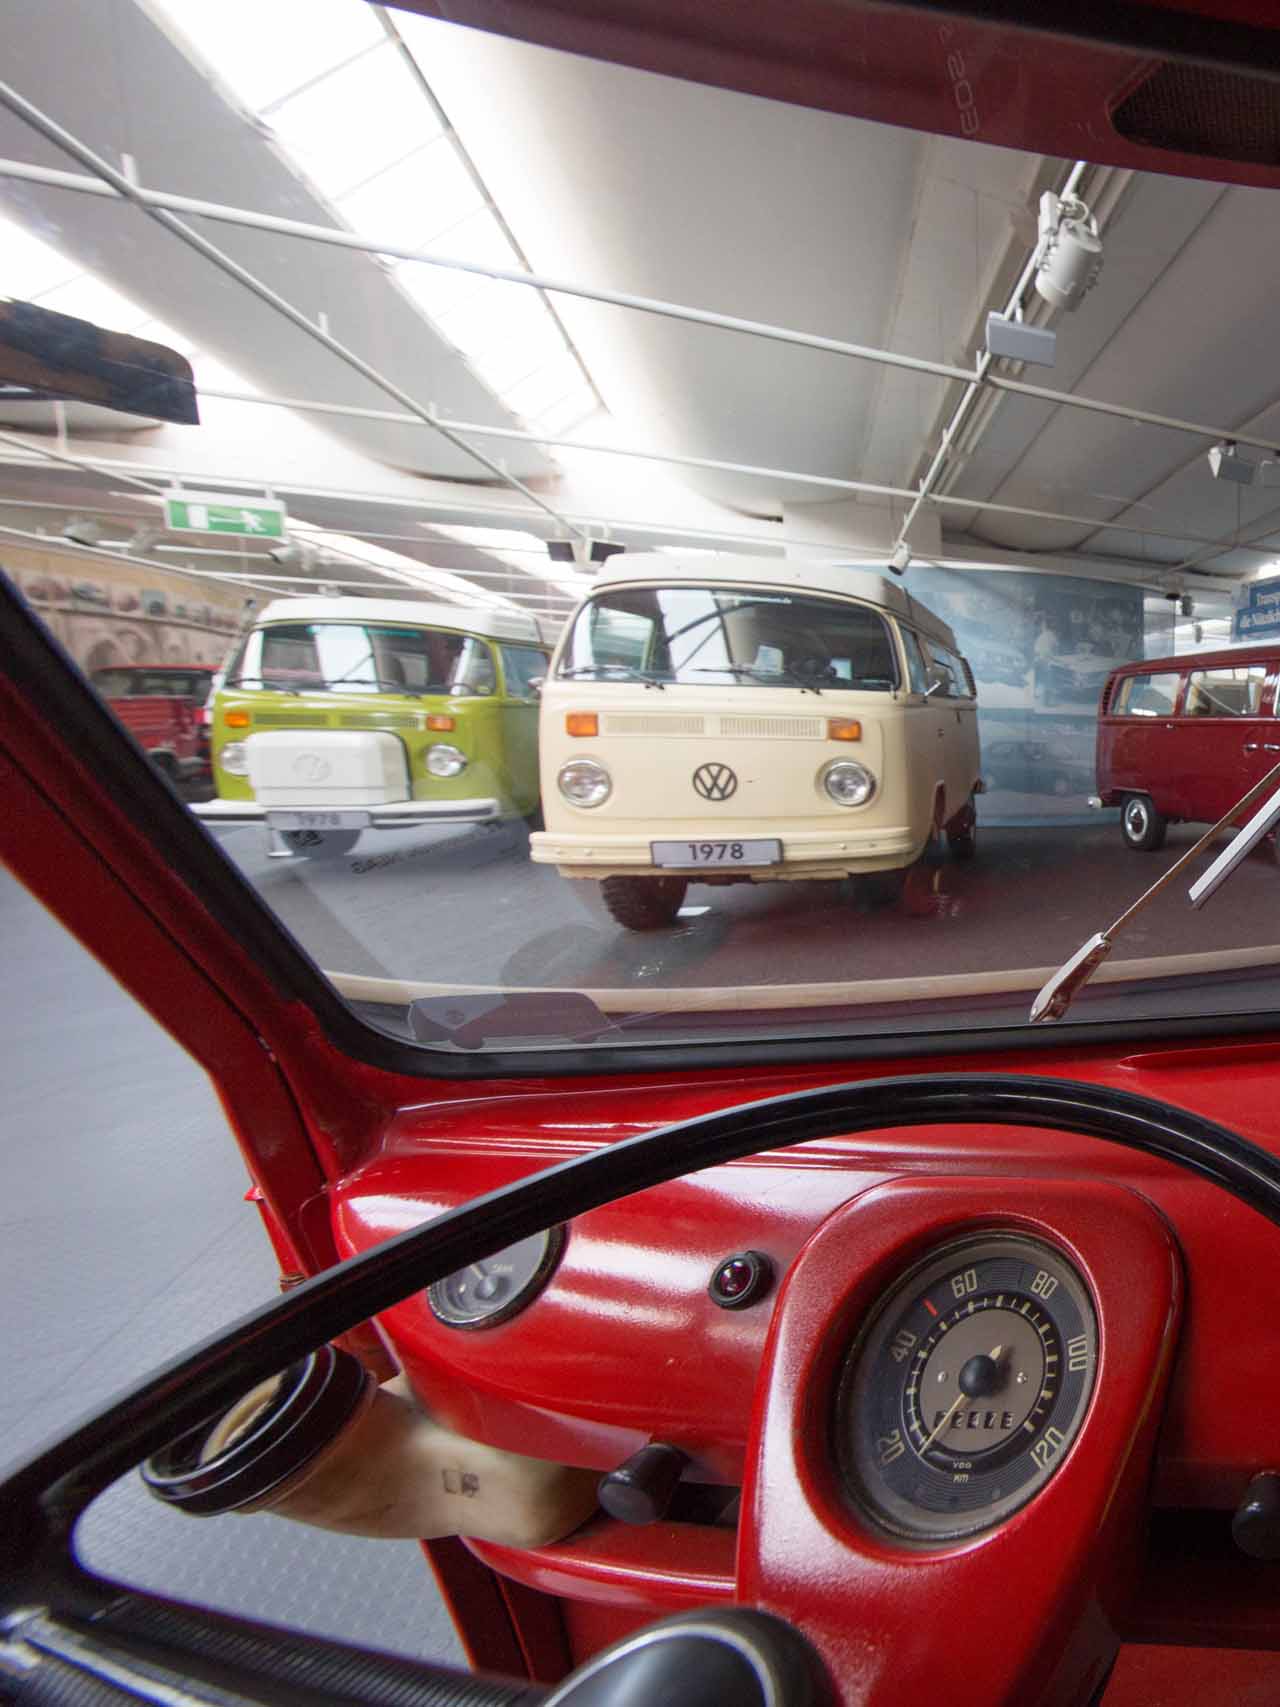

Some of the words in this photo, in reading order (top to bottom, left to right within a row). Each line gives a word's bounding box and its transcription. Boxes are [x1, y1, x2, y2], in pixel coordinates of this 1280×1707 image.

[692, 762, 738, 801] VW
[688, 843, 744, 861] 1978
[951, 1269, 977, 1299] 60
[1030, 1270, 1058, 1300] 80
[892, 1331, 917, 1362] 40
[1067, 1334, 1089, 1373] 100
[878, 1428, 905, 1465] 20
[1029, 1426, 1065, 1470] 120
